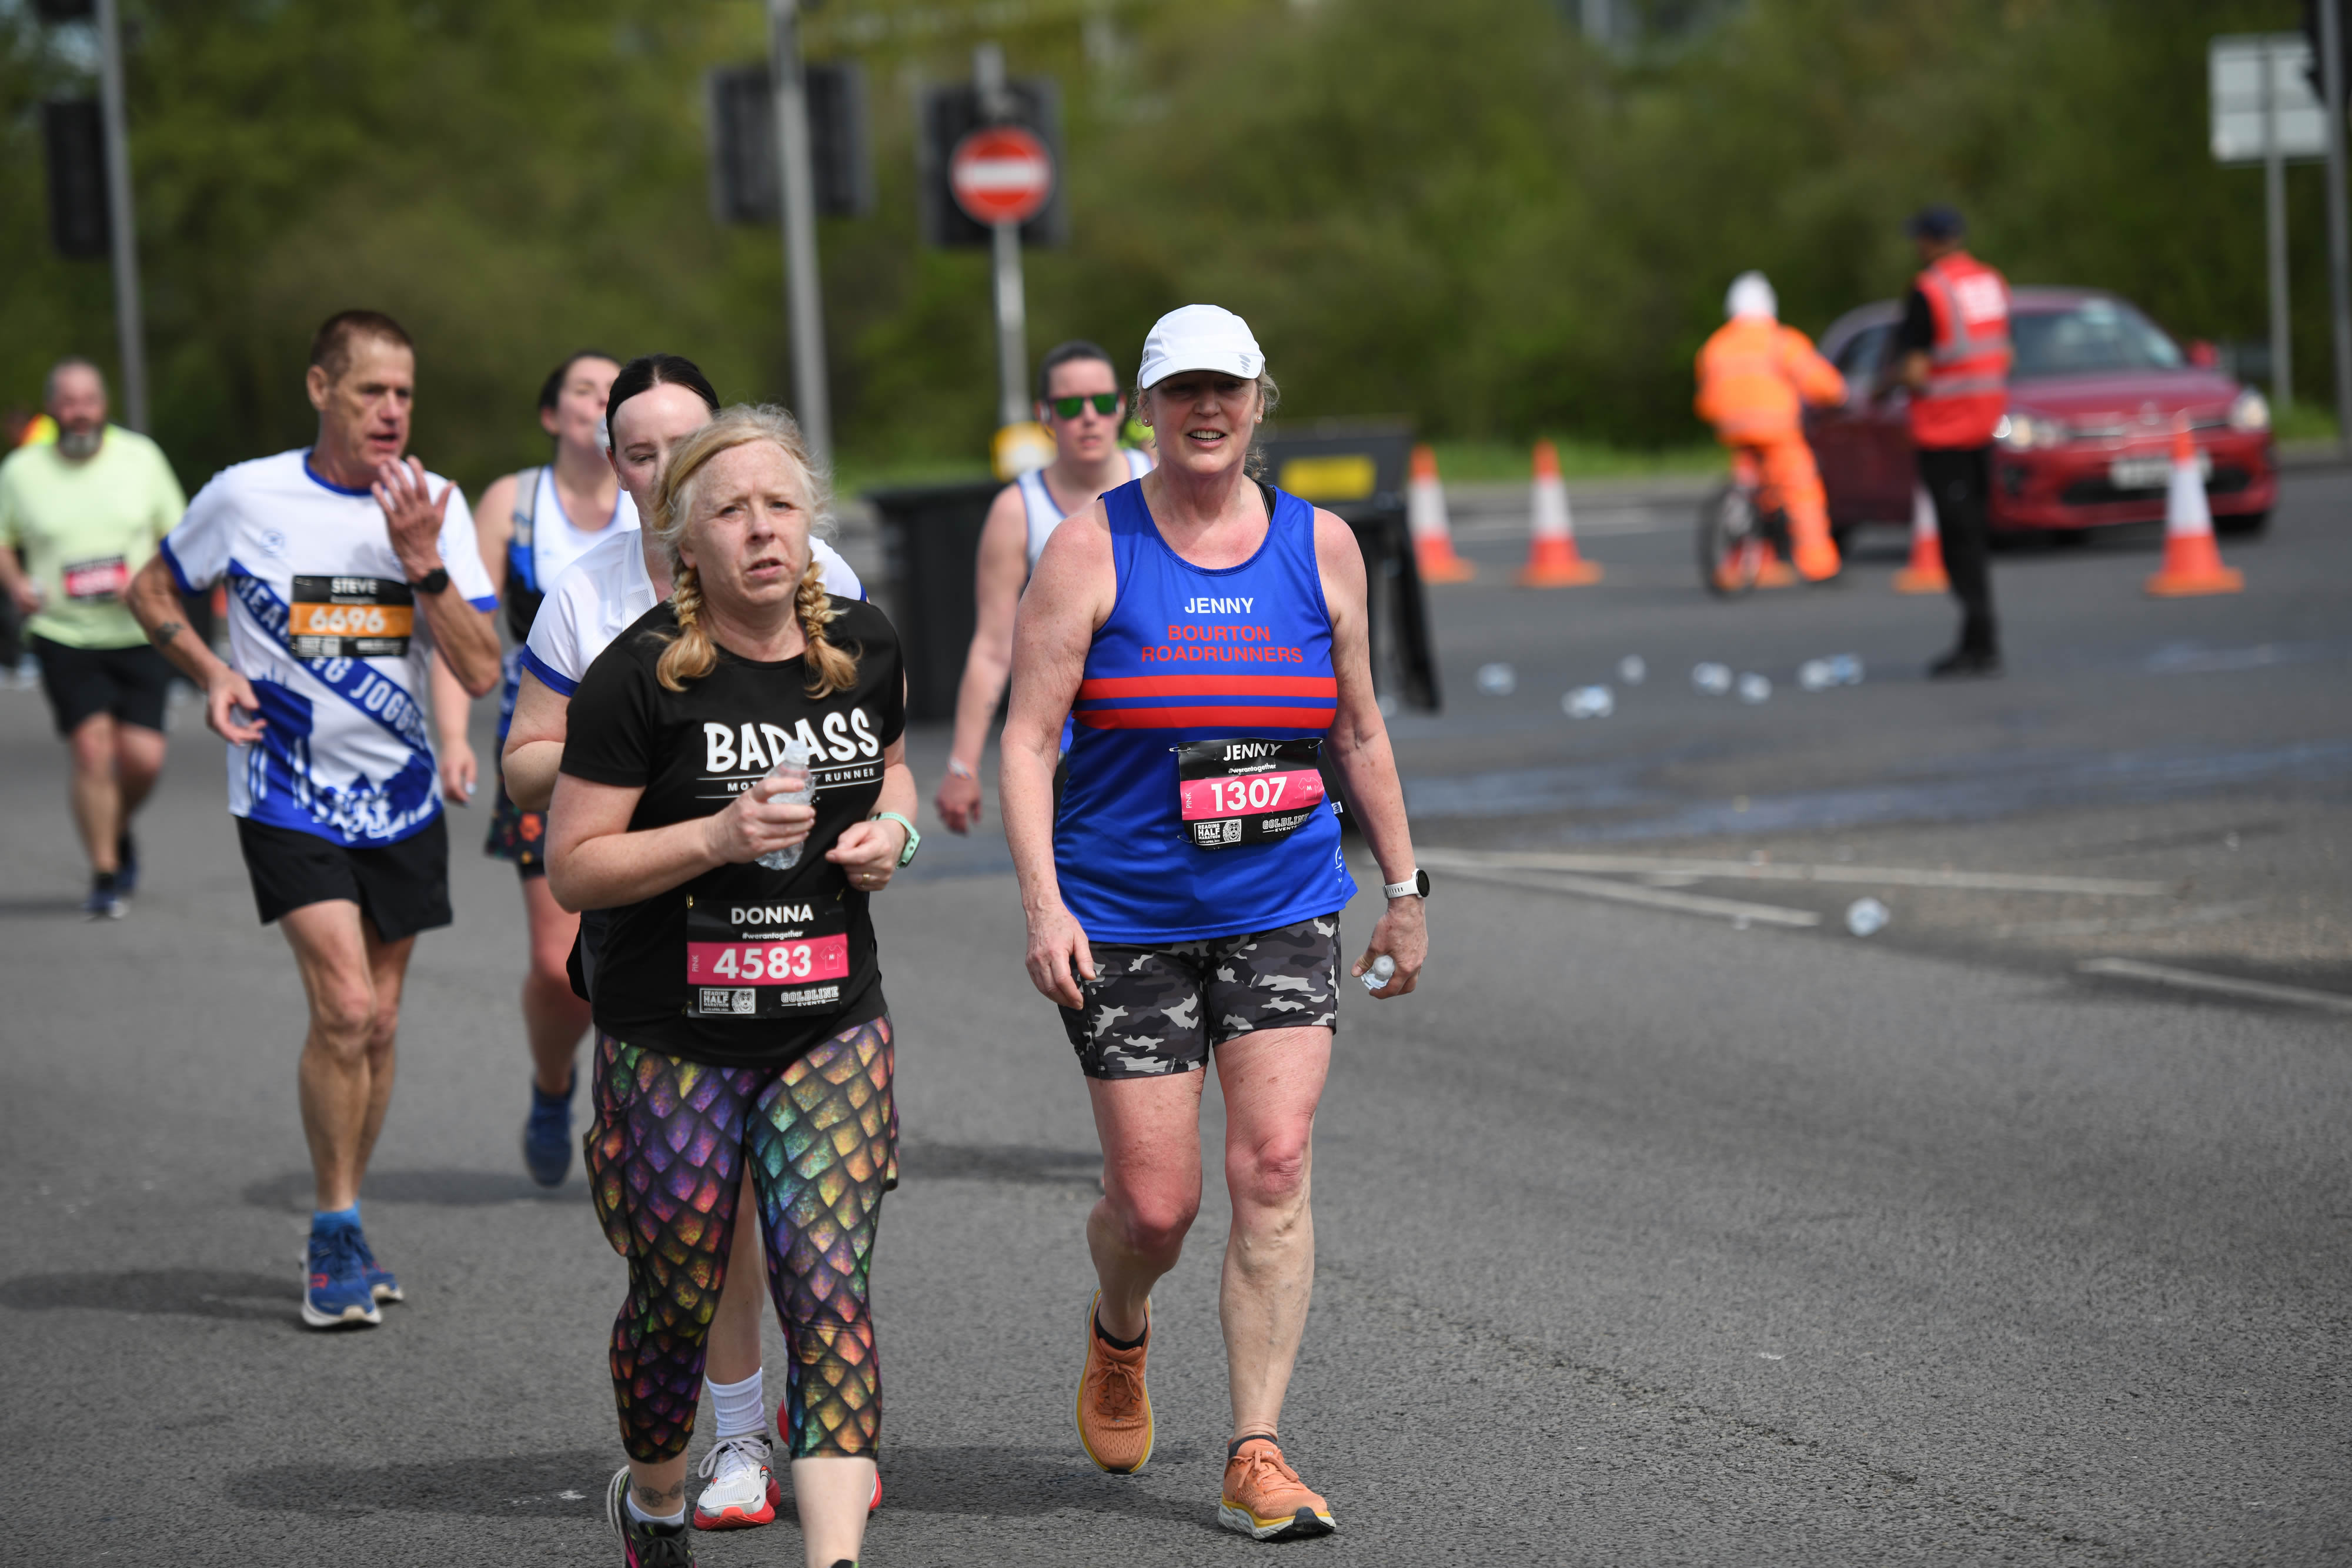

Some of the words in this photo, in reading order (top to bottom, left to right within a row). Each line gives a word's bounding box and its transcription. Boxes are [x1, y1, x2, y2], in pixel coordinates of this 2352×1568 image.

[331, 577, 377, 594] STEVE
[1184, 597, 1254, 614] JENNY
[309, 606, 386, 633] 6696
[1168, 625, 1271, 642] BOURTON
[1141, 646, 1304, 663] ROADRUNNERS
[703, 707, 879, 773] BADASS
[1223, 743, 1282, 761] JENNY
[825, 768, 875, 783] RUNNER
[1228, 763, 1277, 774] #werantogether
[1211, 777, 1288, 812] 1307
[1198, 828, 1220, 836] HALF
[731, 904, 814, 925] DONNA
[742, 930, 804, 941] #werantogether
[713, 945, 812, 979] 4583
[781, 986, 838, 1003] GOLDLINE
